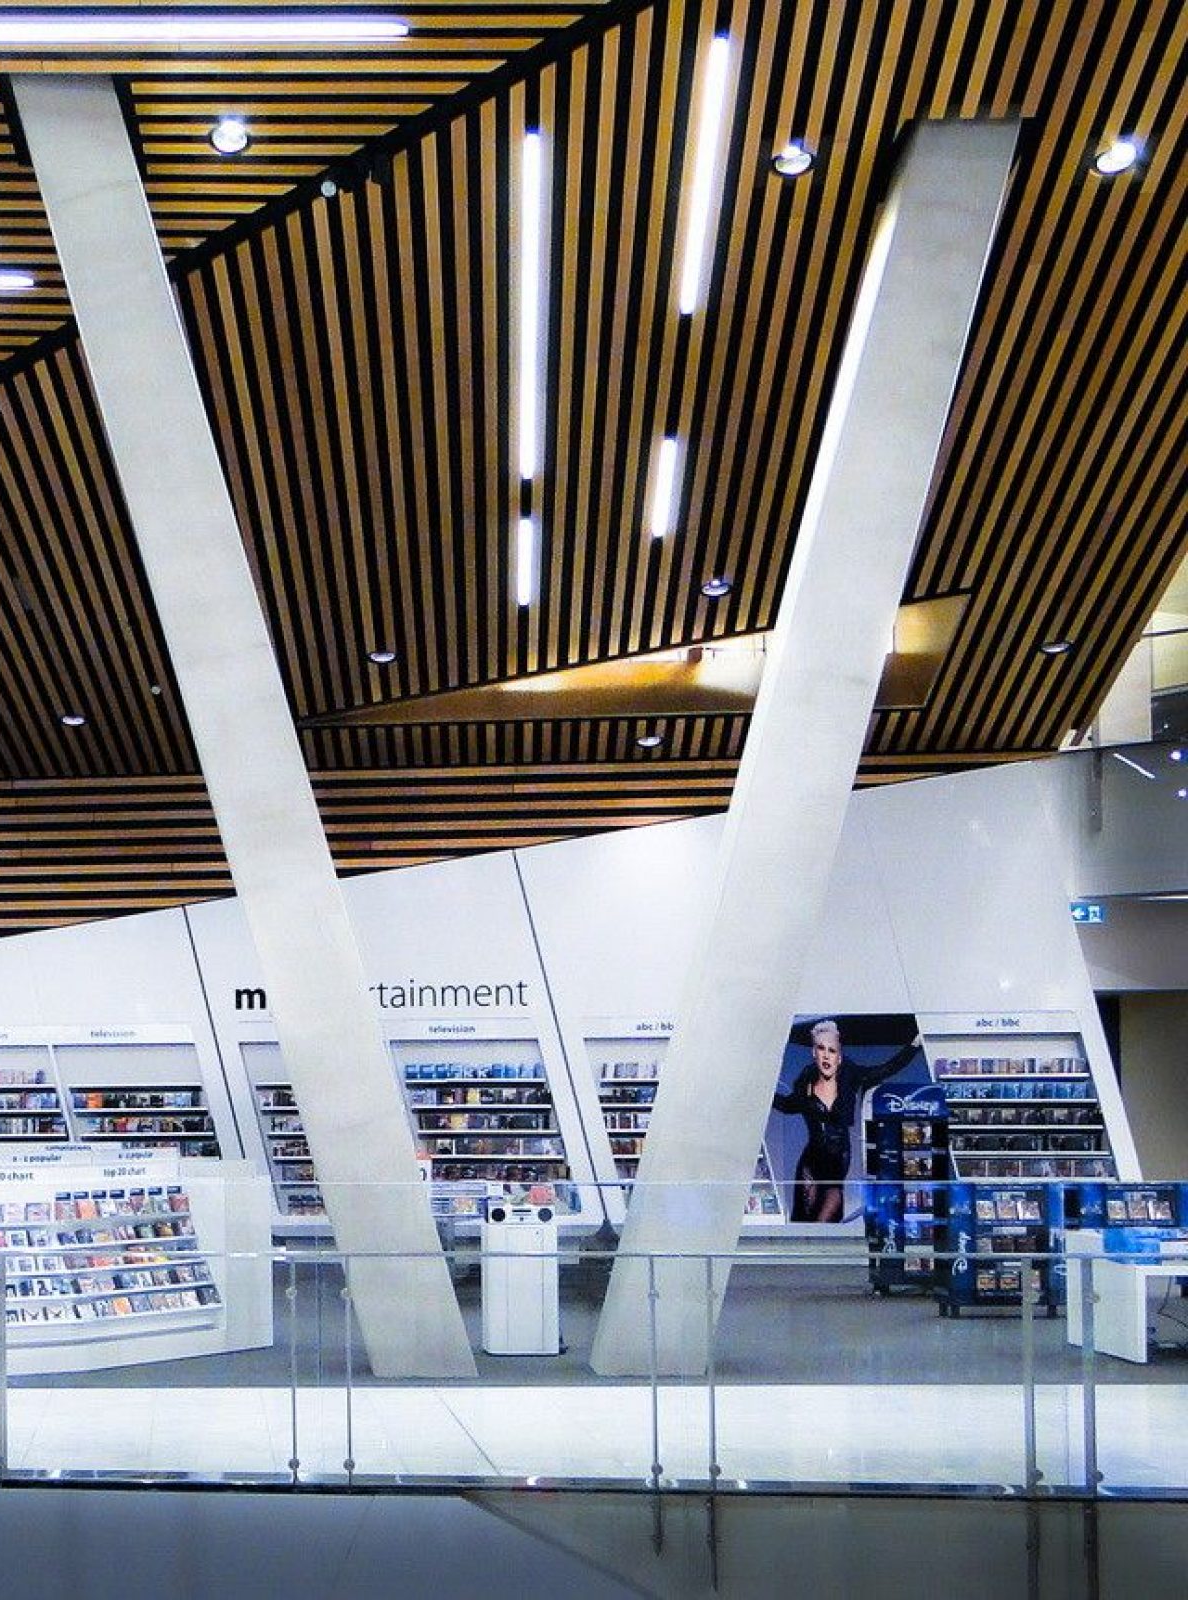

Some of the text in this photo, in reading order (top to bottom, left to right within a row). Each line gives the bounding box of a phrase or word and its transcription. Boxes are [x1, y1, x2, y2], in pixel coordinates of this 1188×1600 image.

[428, 1025, 476, 1033] television
[90, 1030, 137, 1038] television
[883, 1092, 940, 1117] Disney
[29, 1154, 62, 1163] popular
[7, 1171, 34, 1181] chart
[103, 1168, 117, 1178] top
[127, 1167, 146, 1176] chart
